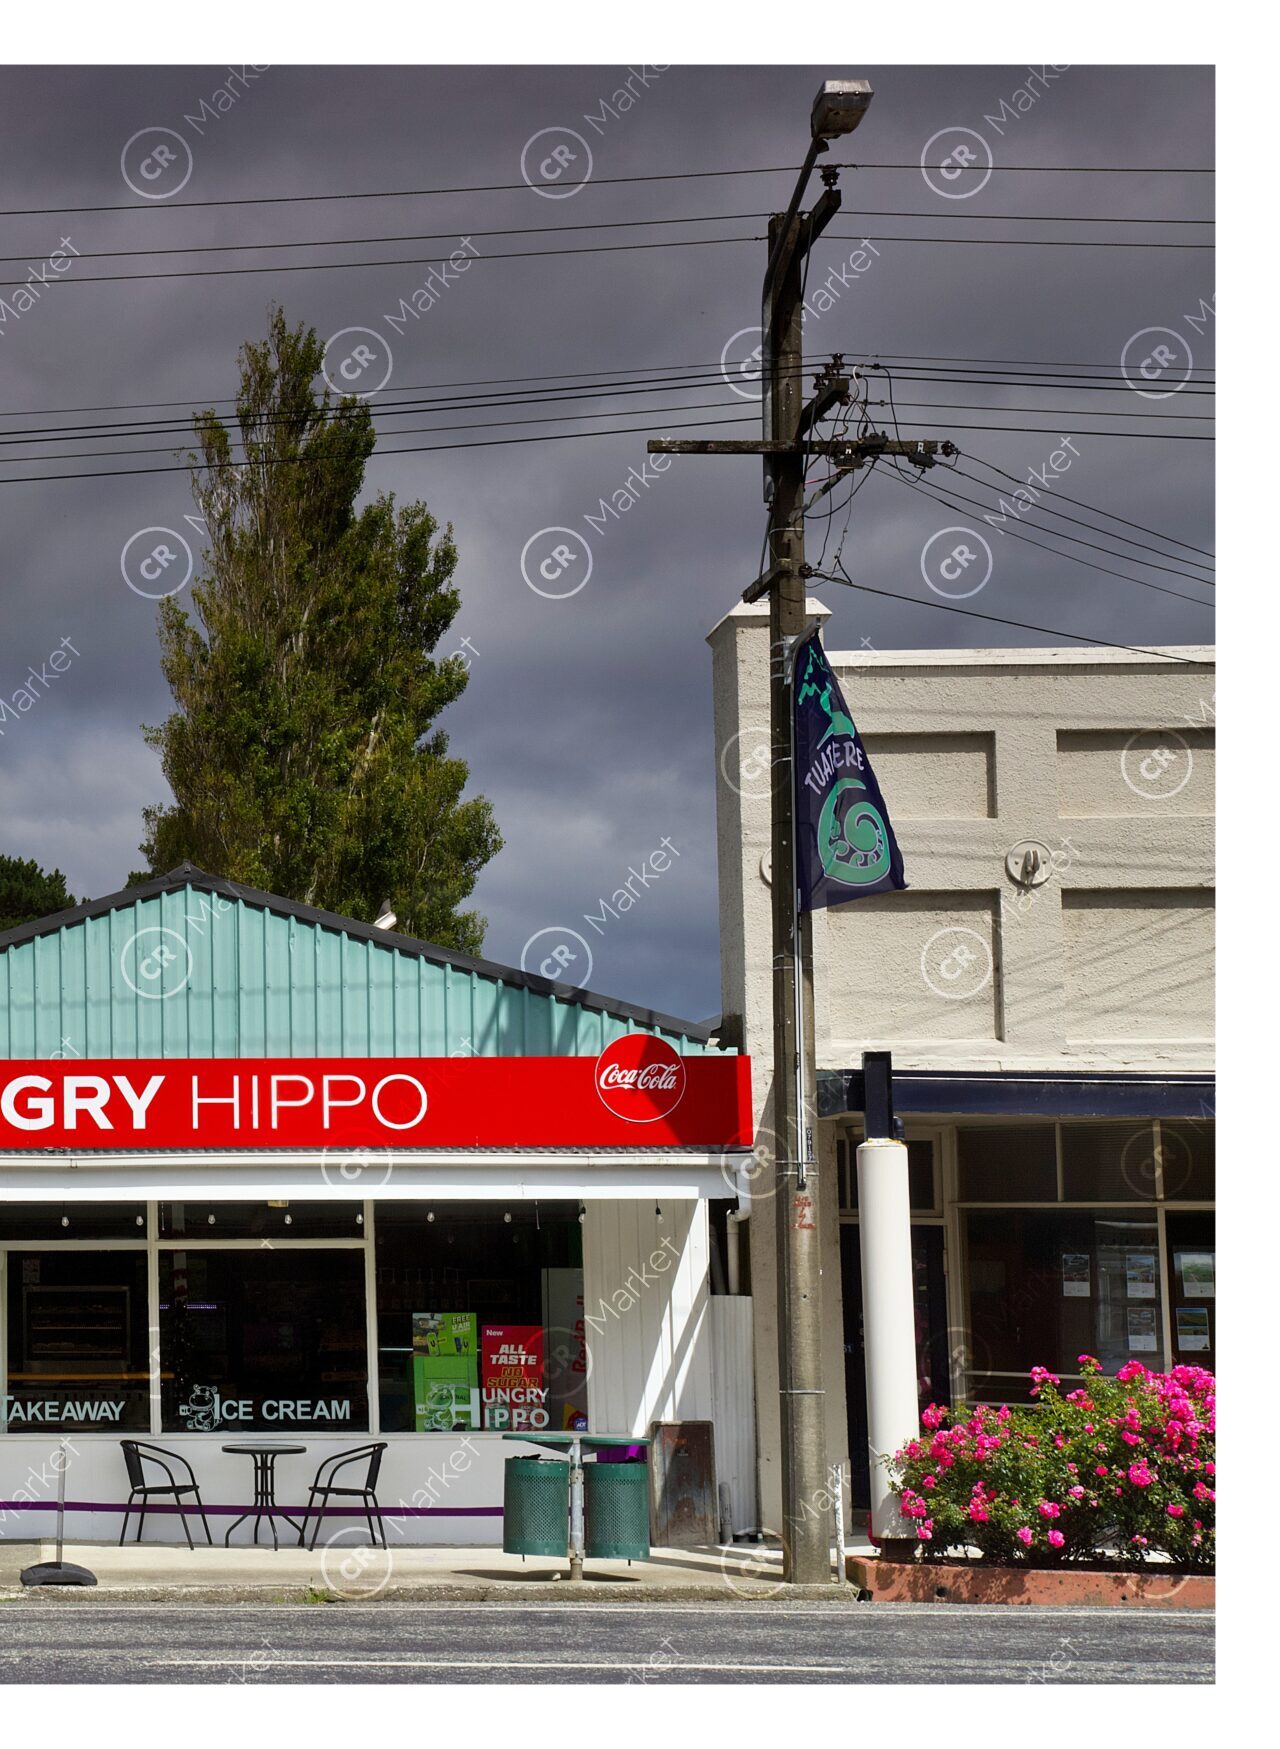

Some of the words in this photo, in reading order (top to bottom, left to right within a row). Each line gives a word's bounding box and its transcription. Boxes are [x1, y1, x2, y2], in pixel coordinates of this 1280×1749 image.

[192, 1073, 428, 1131] HIPPO
[486, 1329, 504, 1337] New
[499, 1344, 526, 1355] ALL
[489, 1355, 537, 1365] TASTE
[501, 1367, 524, 1377] NO
[487, 1377, 539, 1388] SUGAR
[2, 1395, 126, 1422] TAKEAWAY
[215, 1394, 254, 1421] ICE
[261, 1399, 351, 1421] CREAM
